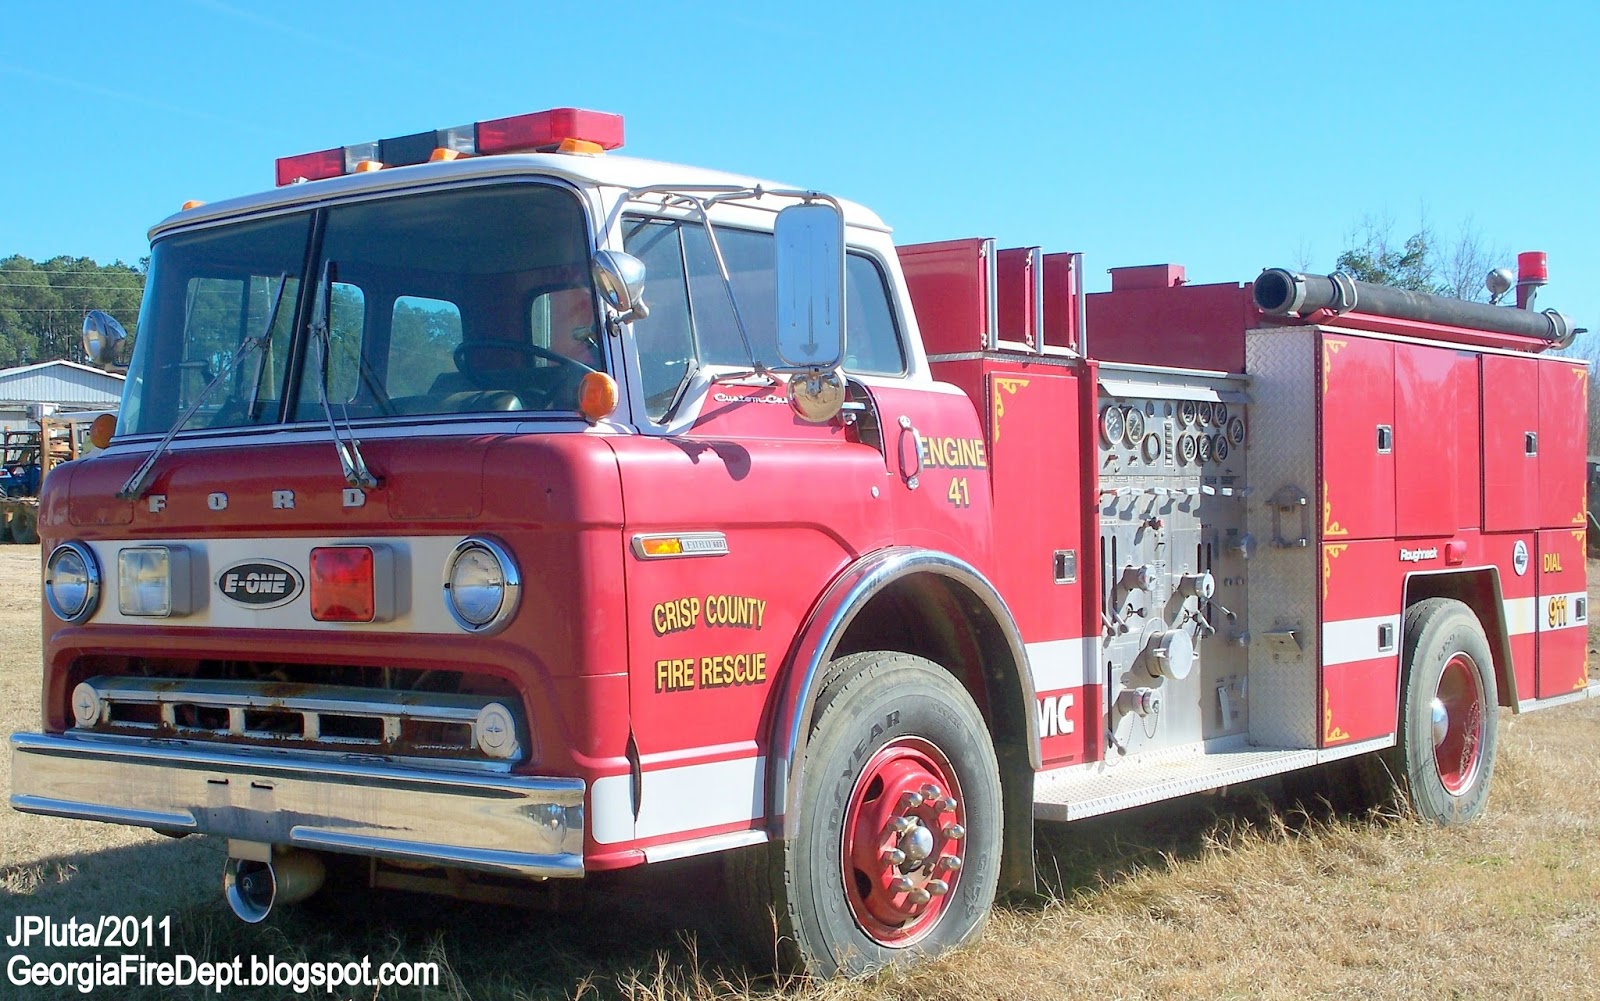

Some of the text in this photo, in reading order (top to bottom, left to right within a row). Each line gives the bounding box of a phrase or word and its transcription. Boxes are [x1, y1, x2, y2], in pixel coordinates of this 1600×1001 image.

[713, 393, 789, 404] Custom Ca
[919, 436, 986, 469] ENGINE
[149, 488, 366, 513] FORD
[948, 477, 970, 507] 41
[686, 540, 712, 549] FORD
[1400, 547, 1438, 562] Roughneck
[1543, 553, 1562, 572] DIAL
[225, 572, 287, 594] E-ONE
[653, 595, 766, 635] CRISP COUNTY
[1548, 597, 1567, 626] 911
[656, 653, 766, 692] FIRE RESCUE
[1036, 693, 1074, 738] MC
[825, 710, 900, 914] GOODYEAR
